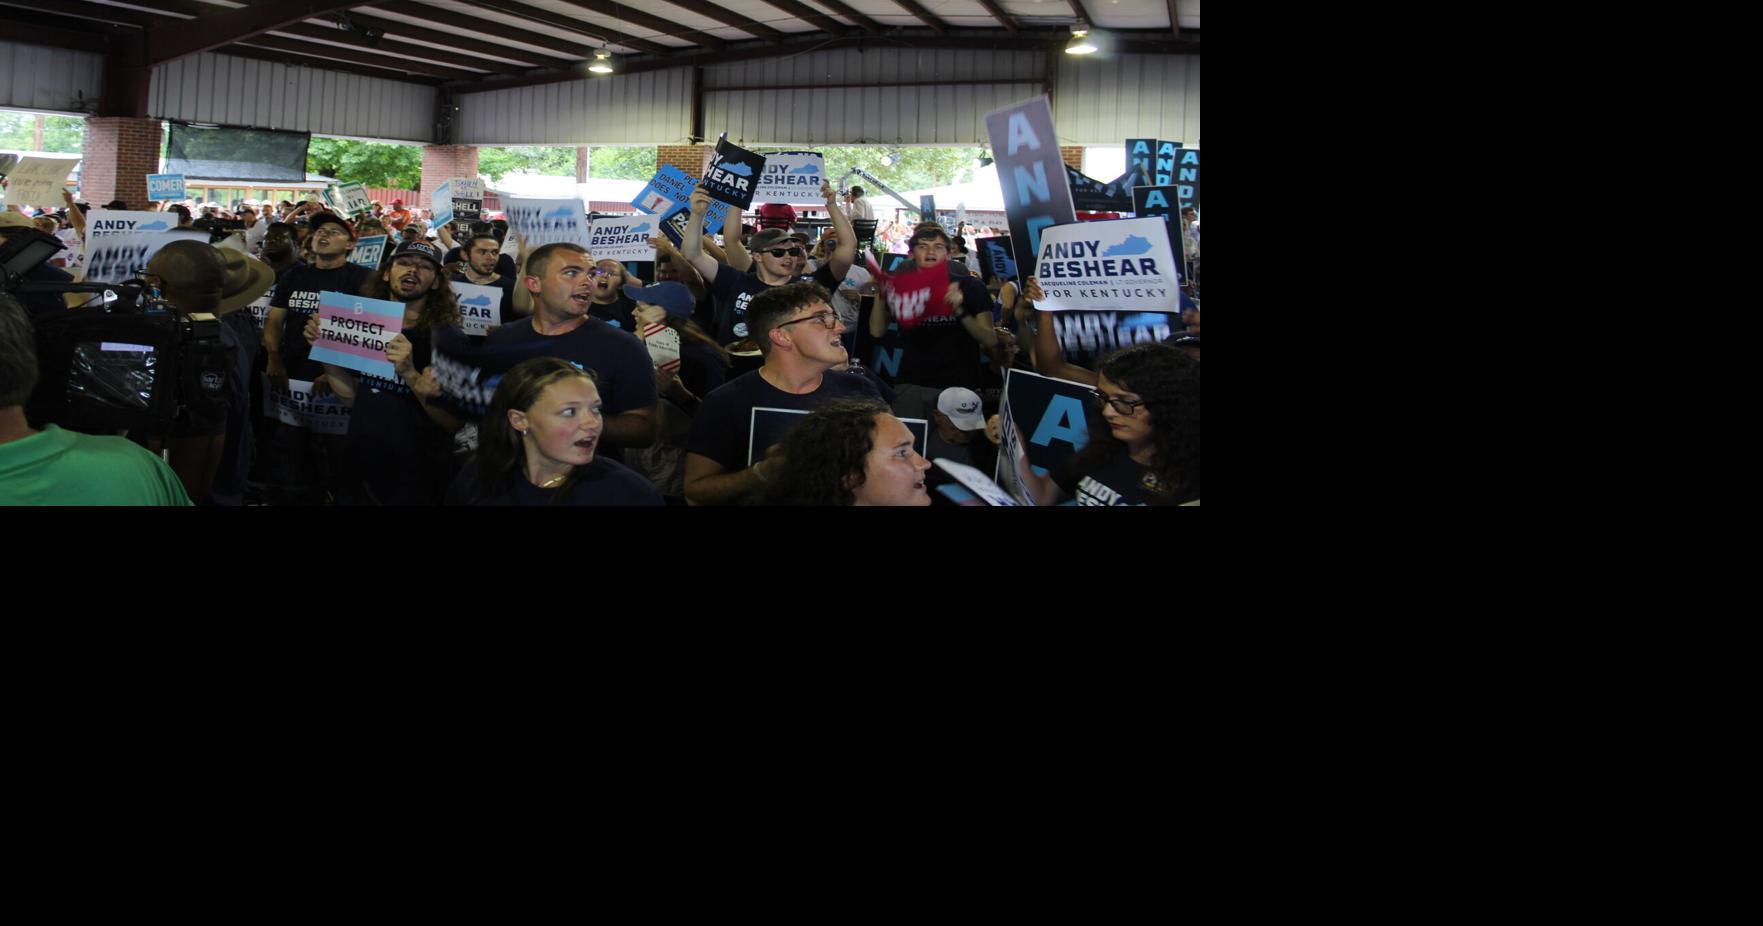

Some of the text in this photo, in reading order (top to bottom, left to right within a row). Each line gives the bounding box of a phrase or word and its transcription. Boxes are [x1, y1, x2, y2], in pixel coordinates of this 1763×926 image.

[1157, 143, 1174, 186] AND
[150, 180, 184, 192] COMER
[707, 165, 749, 192] HEAR
[94, 220, 136, 230] ANDY
[594, 225, 629, 236] ANDY
[591, 234, 649, 246] BESHEAR
[350, 244, 381, 264] MER
[1042, 240, 1101, 260] ANDY
[1039, 258, 1160, 279] BESHEAR
[1045, 288, 1166, 298] FOR KENTUCKY
[331, 315, 384, 336] PROTECT
[321, 328, 358, 347] TRANS
